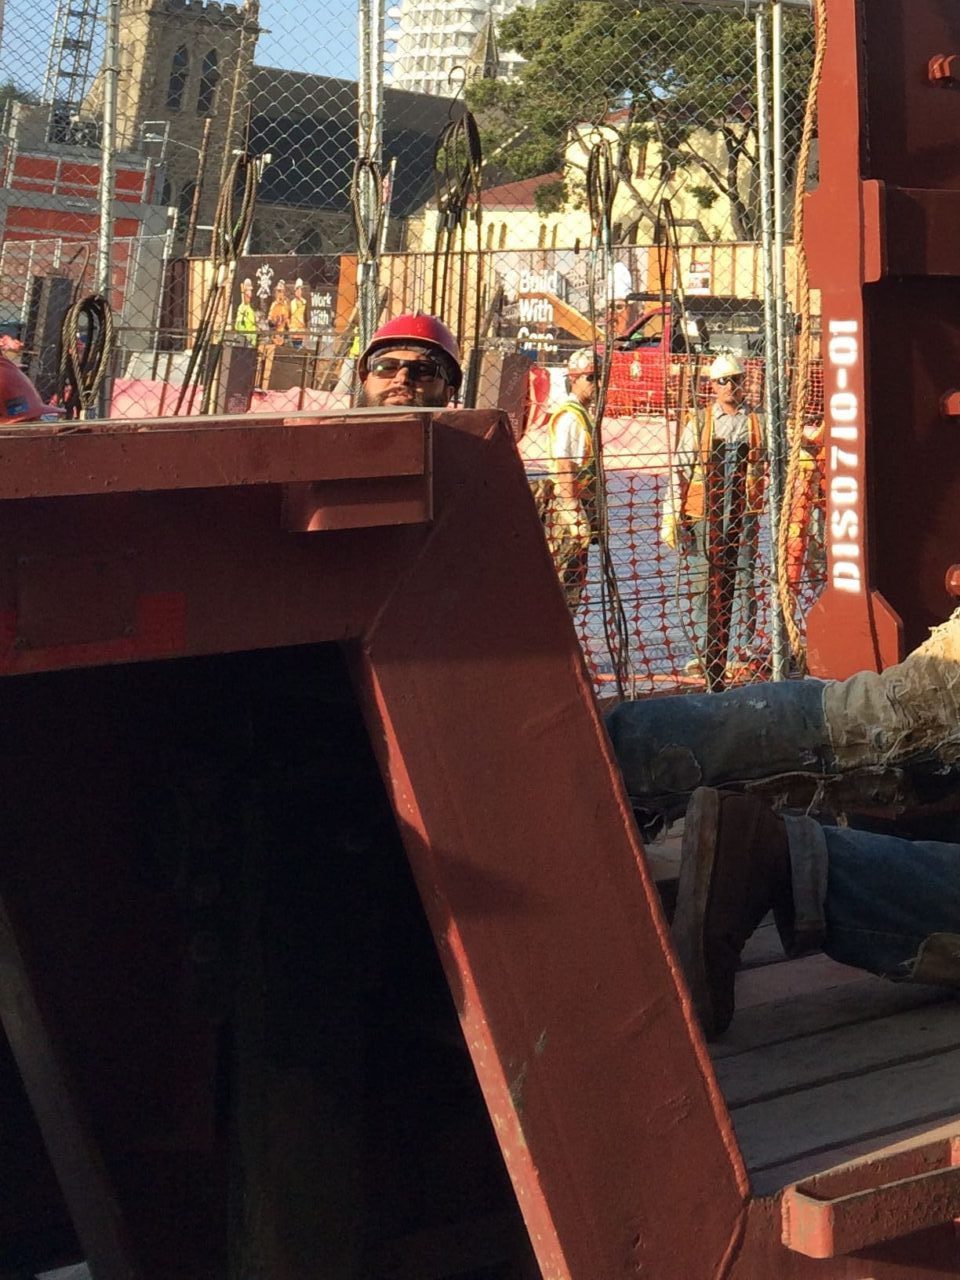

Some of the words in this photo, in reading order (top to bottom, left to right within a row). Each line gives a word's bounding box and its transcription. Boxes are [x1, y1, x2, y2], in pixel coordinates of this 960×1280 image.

[519, 269, 558, 293] Build
[310, 292, 332, 307] Work
[519, 298, 554, 322] With
